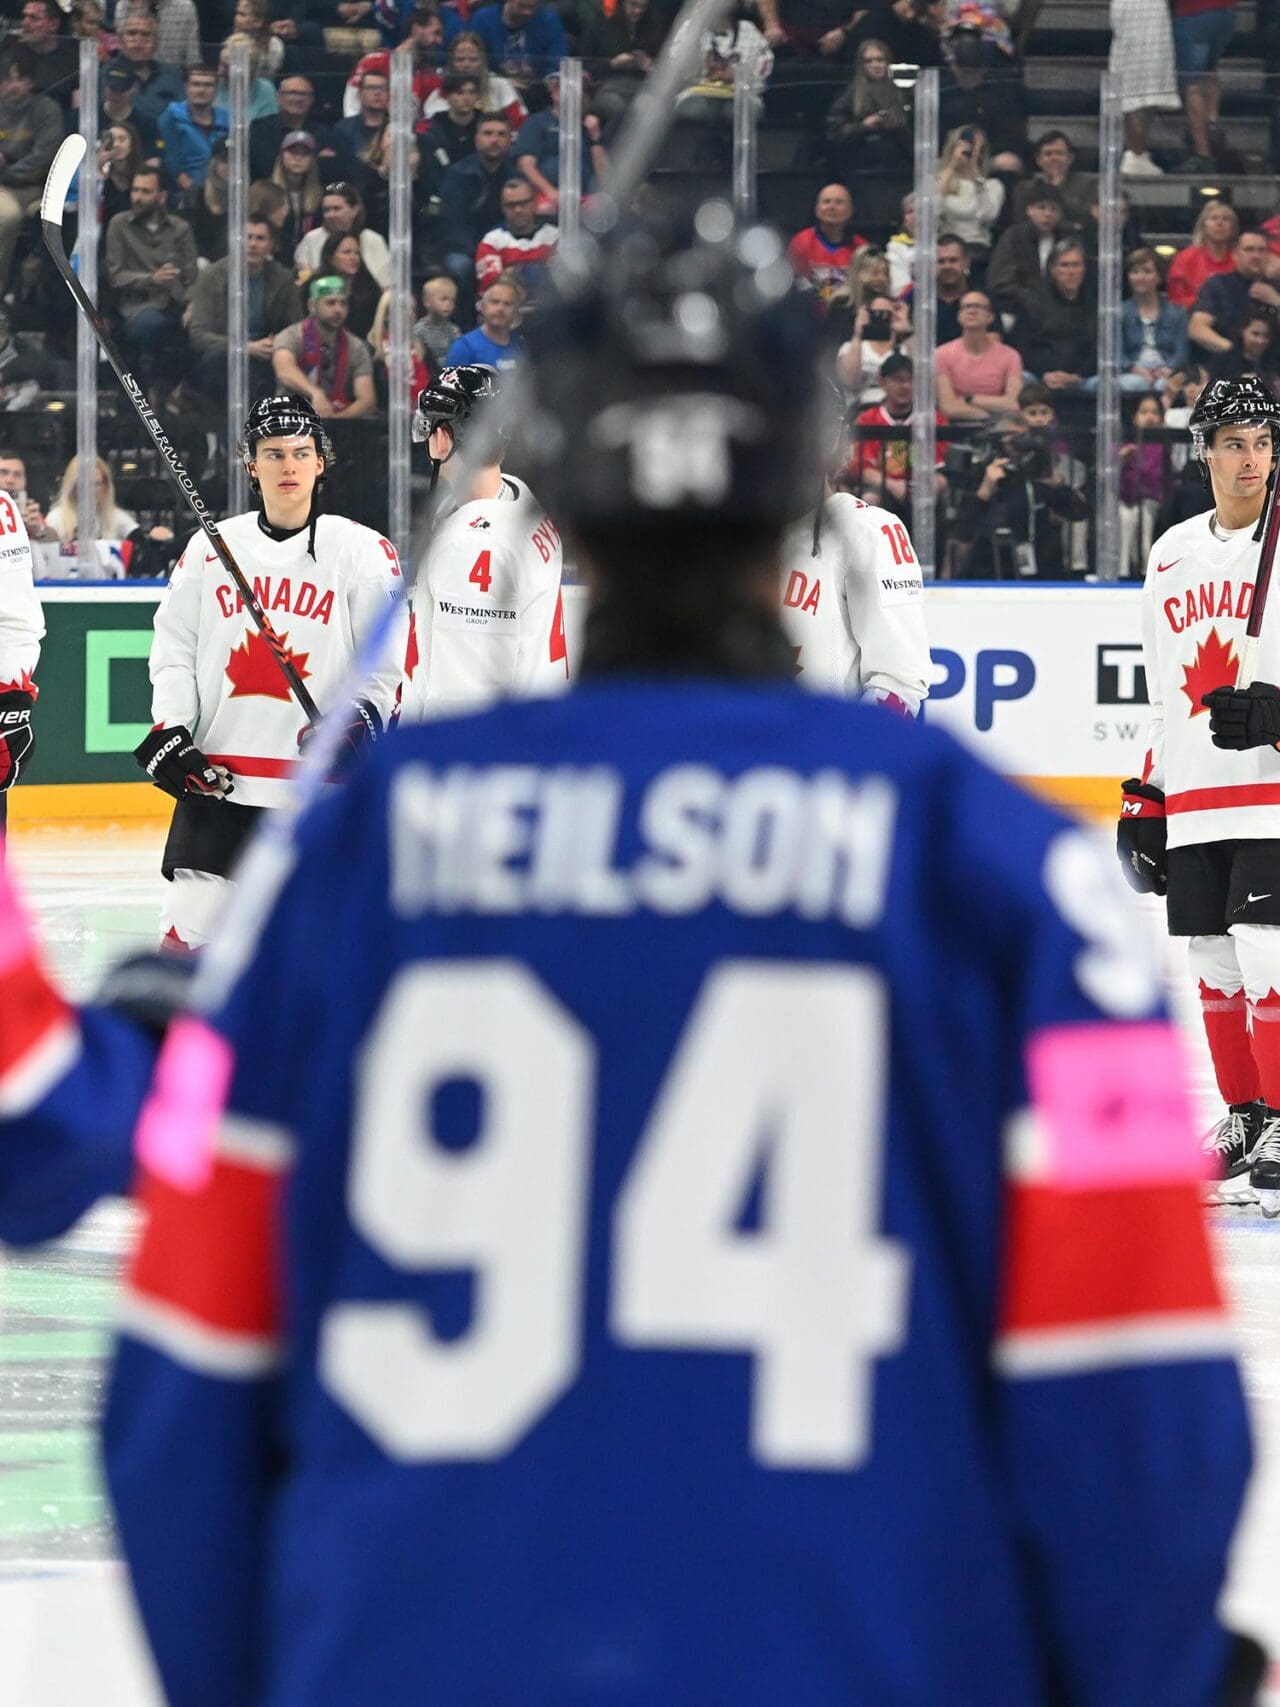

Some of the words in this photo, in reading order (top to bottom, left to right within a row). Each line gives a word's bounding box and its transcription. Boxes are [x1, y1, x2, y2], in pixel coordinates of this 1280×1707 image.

[1242, 402, 1275, 413] TELUS
[121, 372, 221, 537] SHERWOOD
[0, 496, 18, 536] 3
[880, 523, 915, 566] 18
[468, 549, 492, 593] 4
[465, 617, 489, 625] GROUP
[1163, 580, 1257, 634] CANAD
[388, 763, 898, 926] NEILSON
[318, 956, 910, 1472] 94
